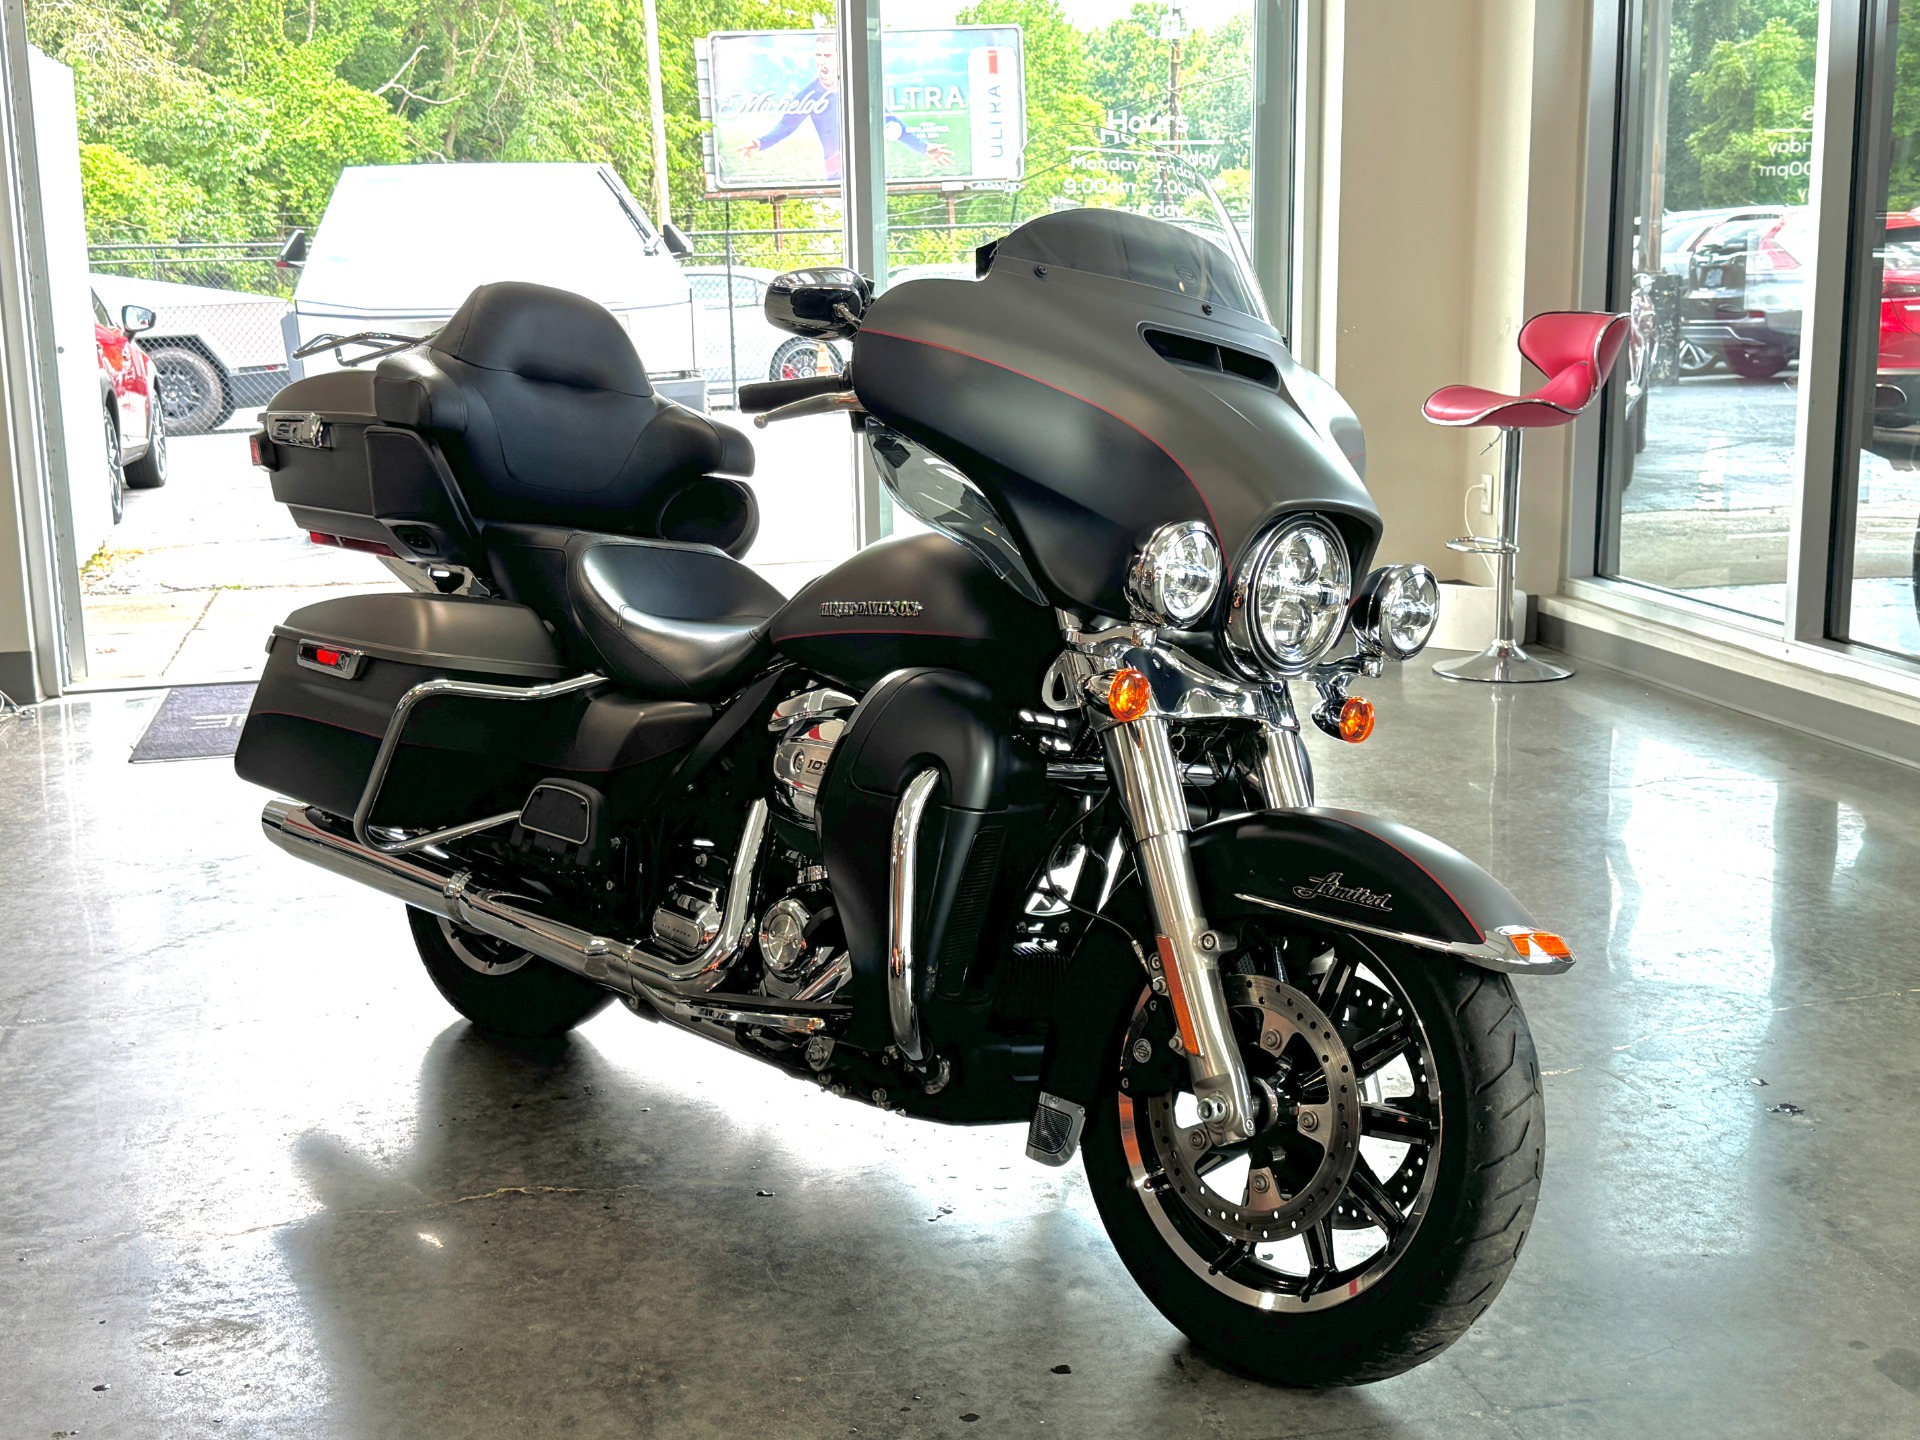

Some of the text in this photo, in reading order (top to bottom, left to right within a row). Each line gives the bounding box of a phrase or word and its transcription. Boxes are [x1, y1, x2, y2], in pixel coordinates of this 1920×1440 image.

[717, 86, 967, 117] Michelob LTRA
[1108, 110, 1189, 133] Hours
[1071, 155, 1141, 174] Monday
[1064, 178, 1136, 194] 9:00am
[820, 600, 923, 618] HARLEY-DAVIDSON
[1292, 871, 1393, 912] Limited
